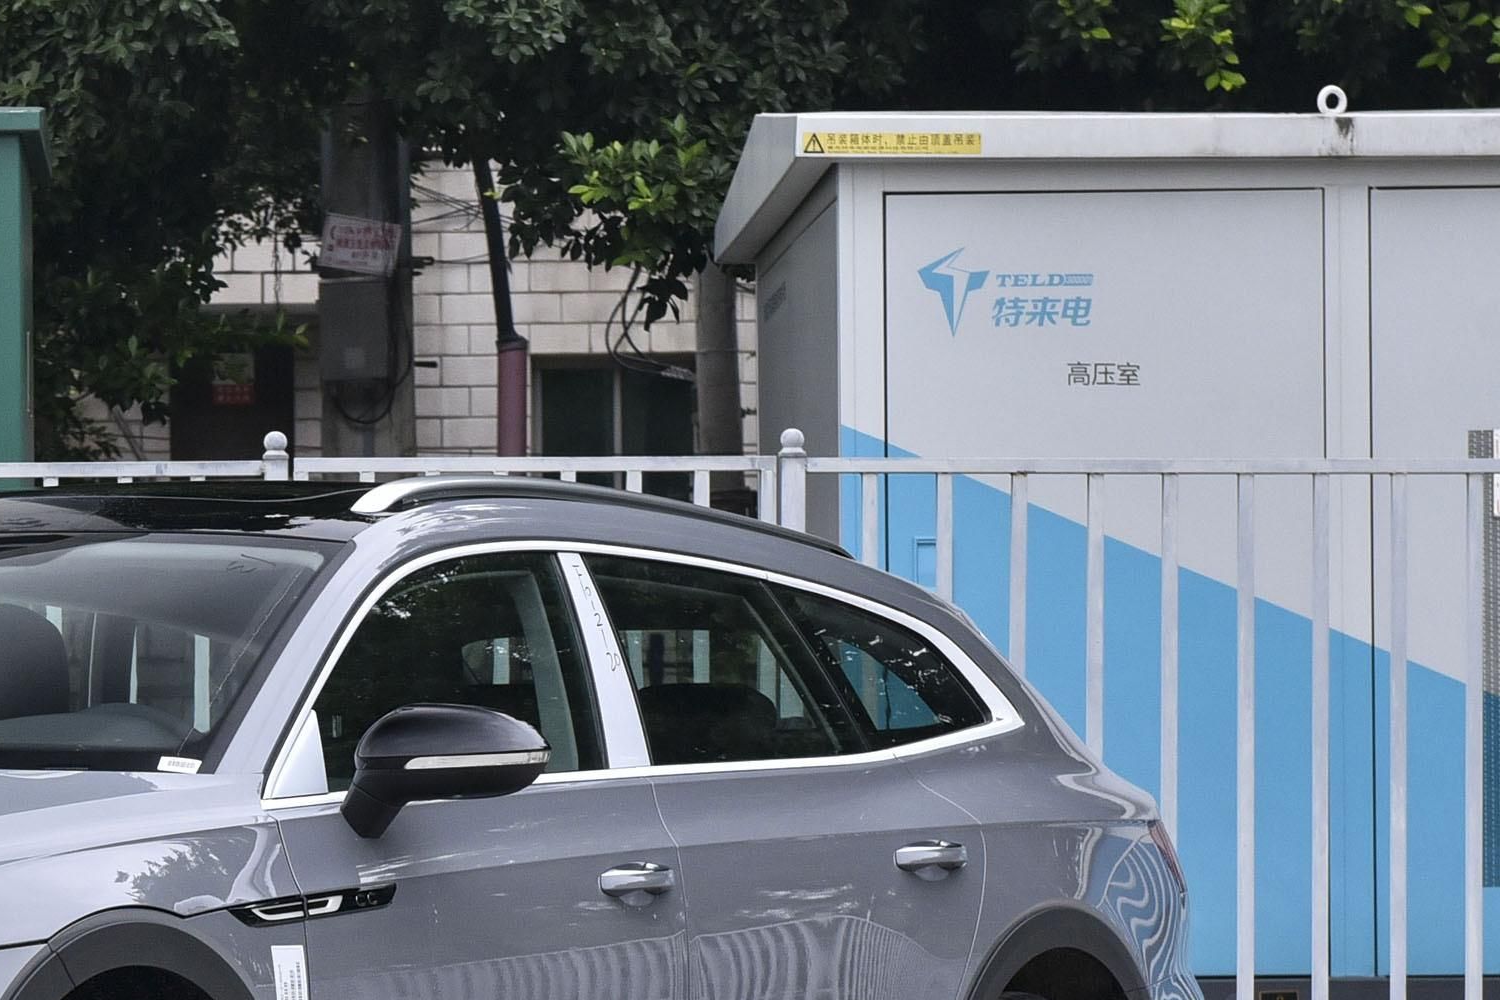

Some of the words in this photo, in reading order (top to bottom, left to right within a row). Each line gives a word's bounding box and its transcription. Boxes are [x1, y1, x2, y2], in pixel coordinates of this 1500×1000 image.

[992, 297, 1093, 327] 特来电
[1067, 361, 1140, 386] 高压室
